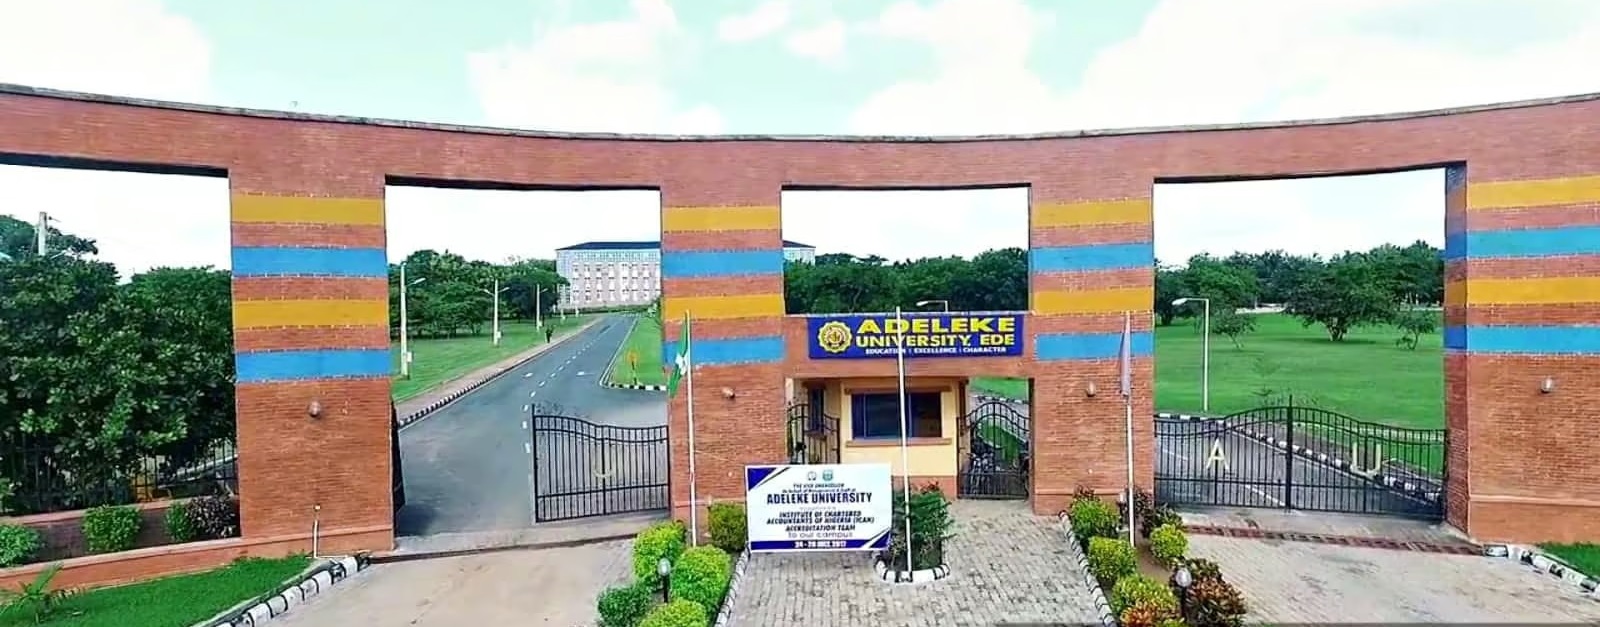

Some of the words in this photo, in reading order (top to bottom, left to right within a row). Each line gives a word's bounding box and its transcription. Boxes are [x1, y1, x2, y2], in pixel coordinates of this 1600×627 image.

[857, 318, 1015, 333] ADELEKE
[980, 334, 1015, 346] EDE
[1206, 438, 1229, 470] A
[767, 493, 809, 504] ADELEKE
[811, 492, 872, 503] UNIVERSITY
[853, 516, 875, 524] (ICAN)
